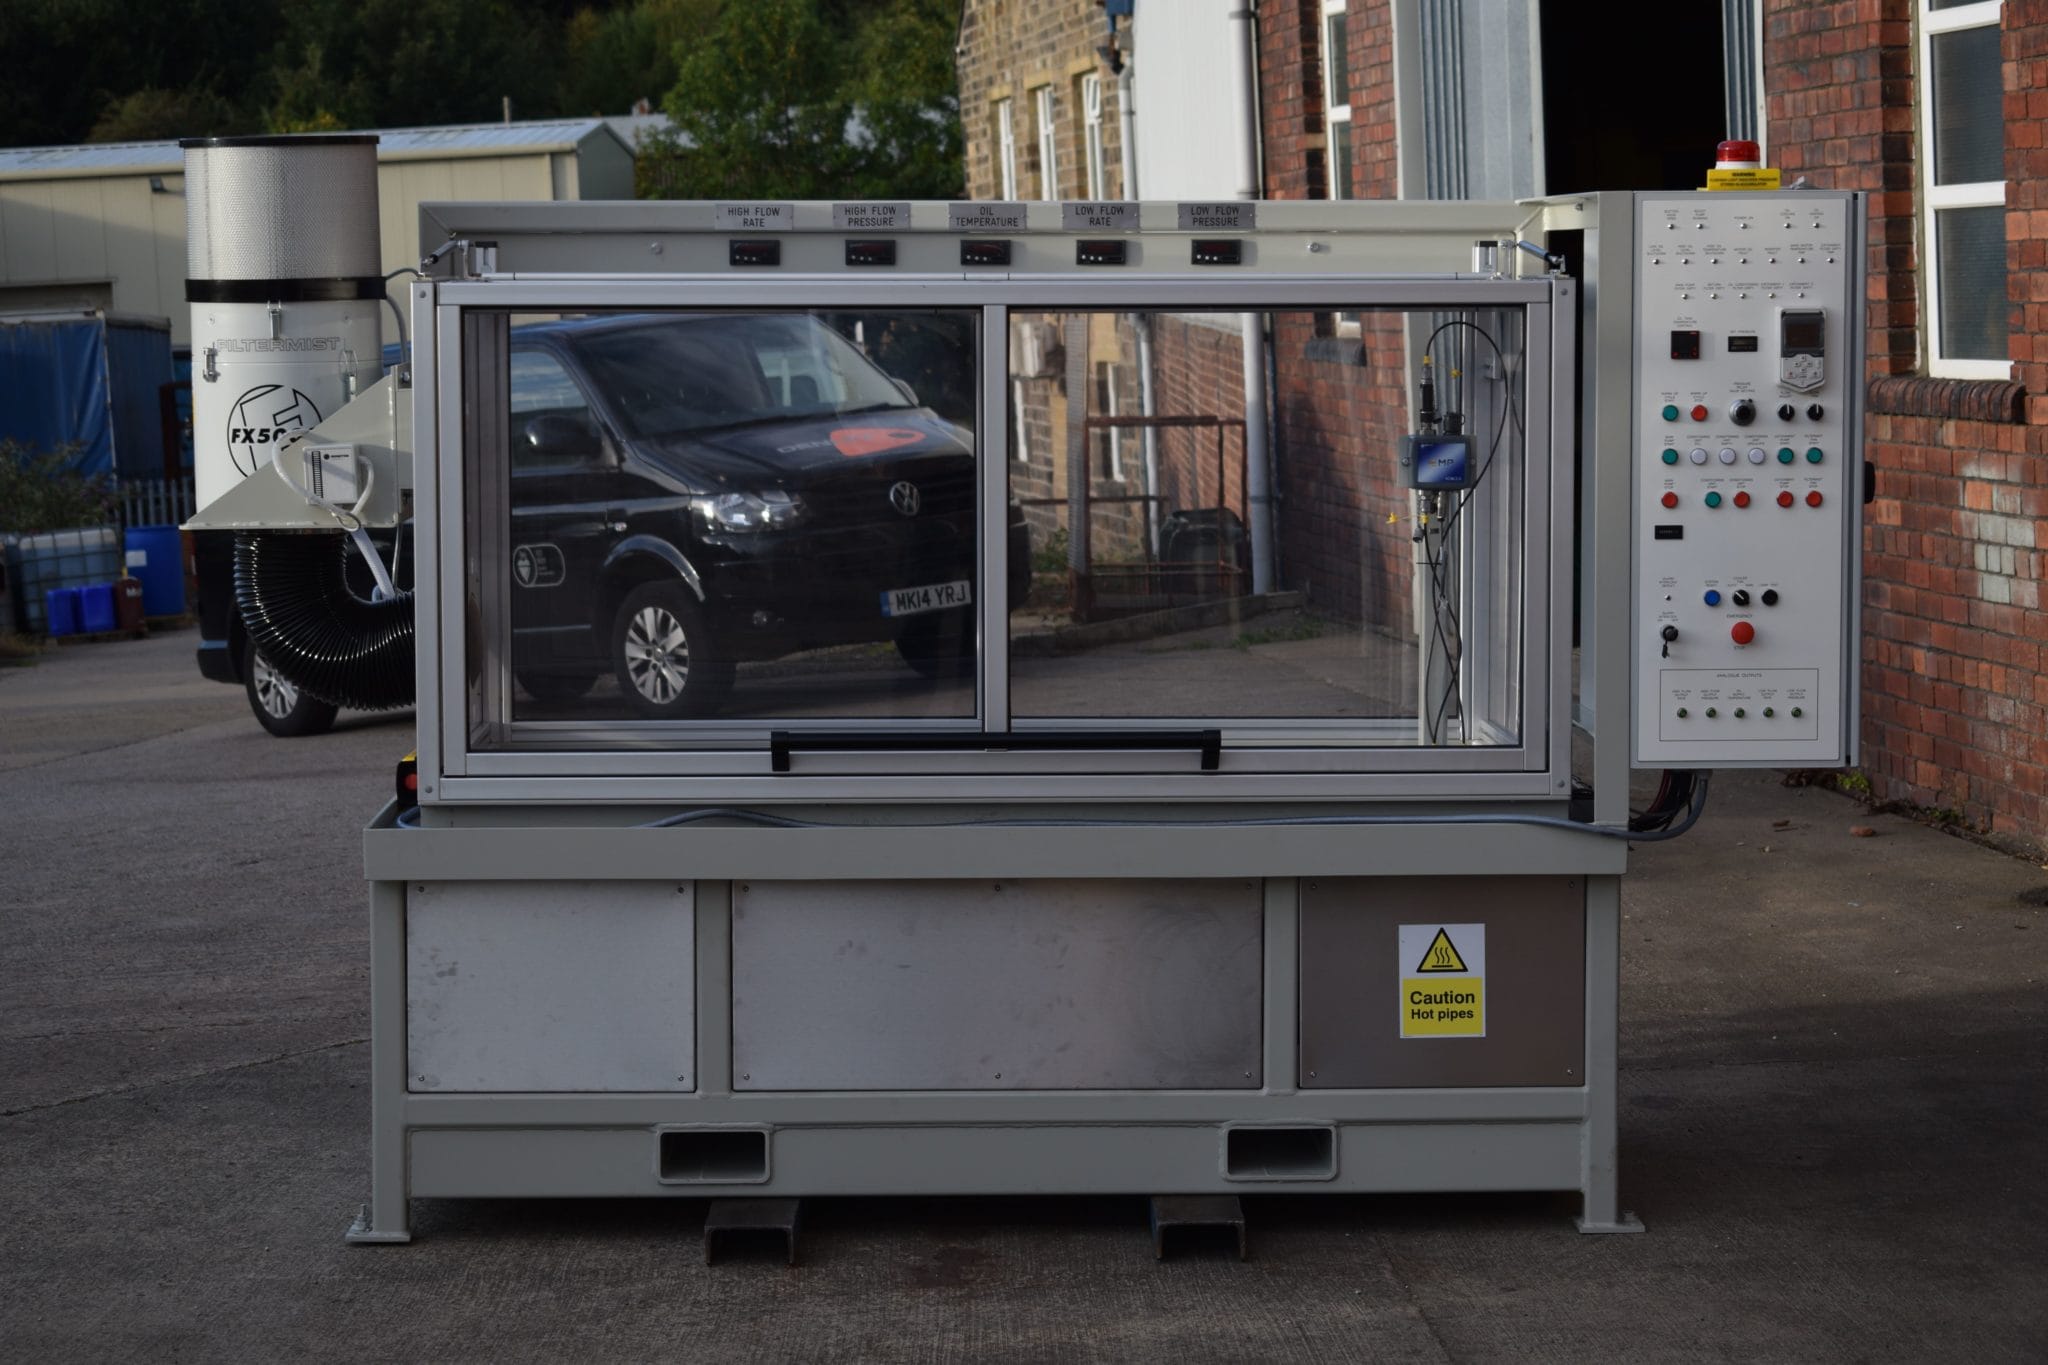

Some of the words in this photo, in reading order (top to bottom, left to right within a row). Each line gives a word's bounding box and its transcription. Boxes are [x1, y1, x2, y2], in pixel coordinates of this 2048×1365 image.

[727, 206, 750, 217] HIGH
[754, 206, 781, 217] FLOW
[844, 206, 867, 217] HIGH
[871, 206, 897, 217] FLOW
[980, 206, 995, 217] OIL
[1075, 206, 1094, 217] LOW
[1100, 206, 1125, 217] FLOW
[1190, 206, 1210, 217] LOW
[1215, 206, 1240, 217] FLOW
[743, 217, 765, 228] RATE
[847, 217, 895, 228] PRESSURE
[955, 217, 1019, 228] TEMPERATURE
[1089, 217, 1111, 227] RATE
[1192, 217, 1239, 228] PRESSURE
[216, 337, 340, 353] FILTERMIST
[896, 591, 931, 612] MK14
[935, 584, 967, 605] YRJ
[1410, 990, 1476, 1006] Caution
[1411, 1007, 1435, 1021] Hot
[1438, 1007, 1475, 1023] pipes
